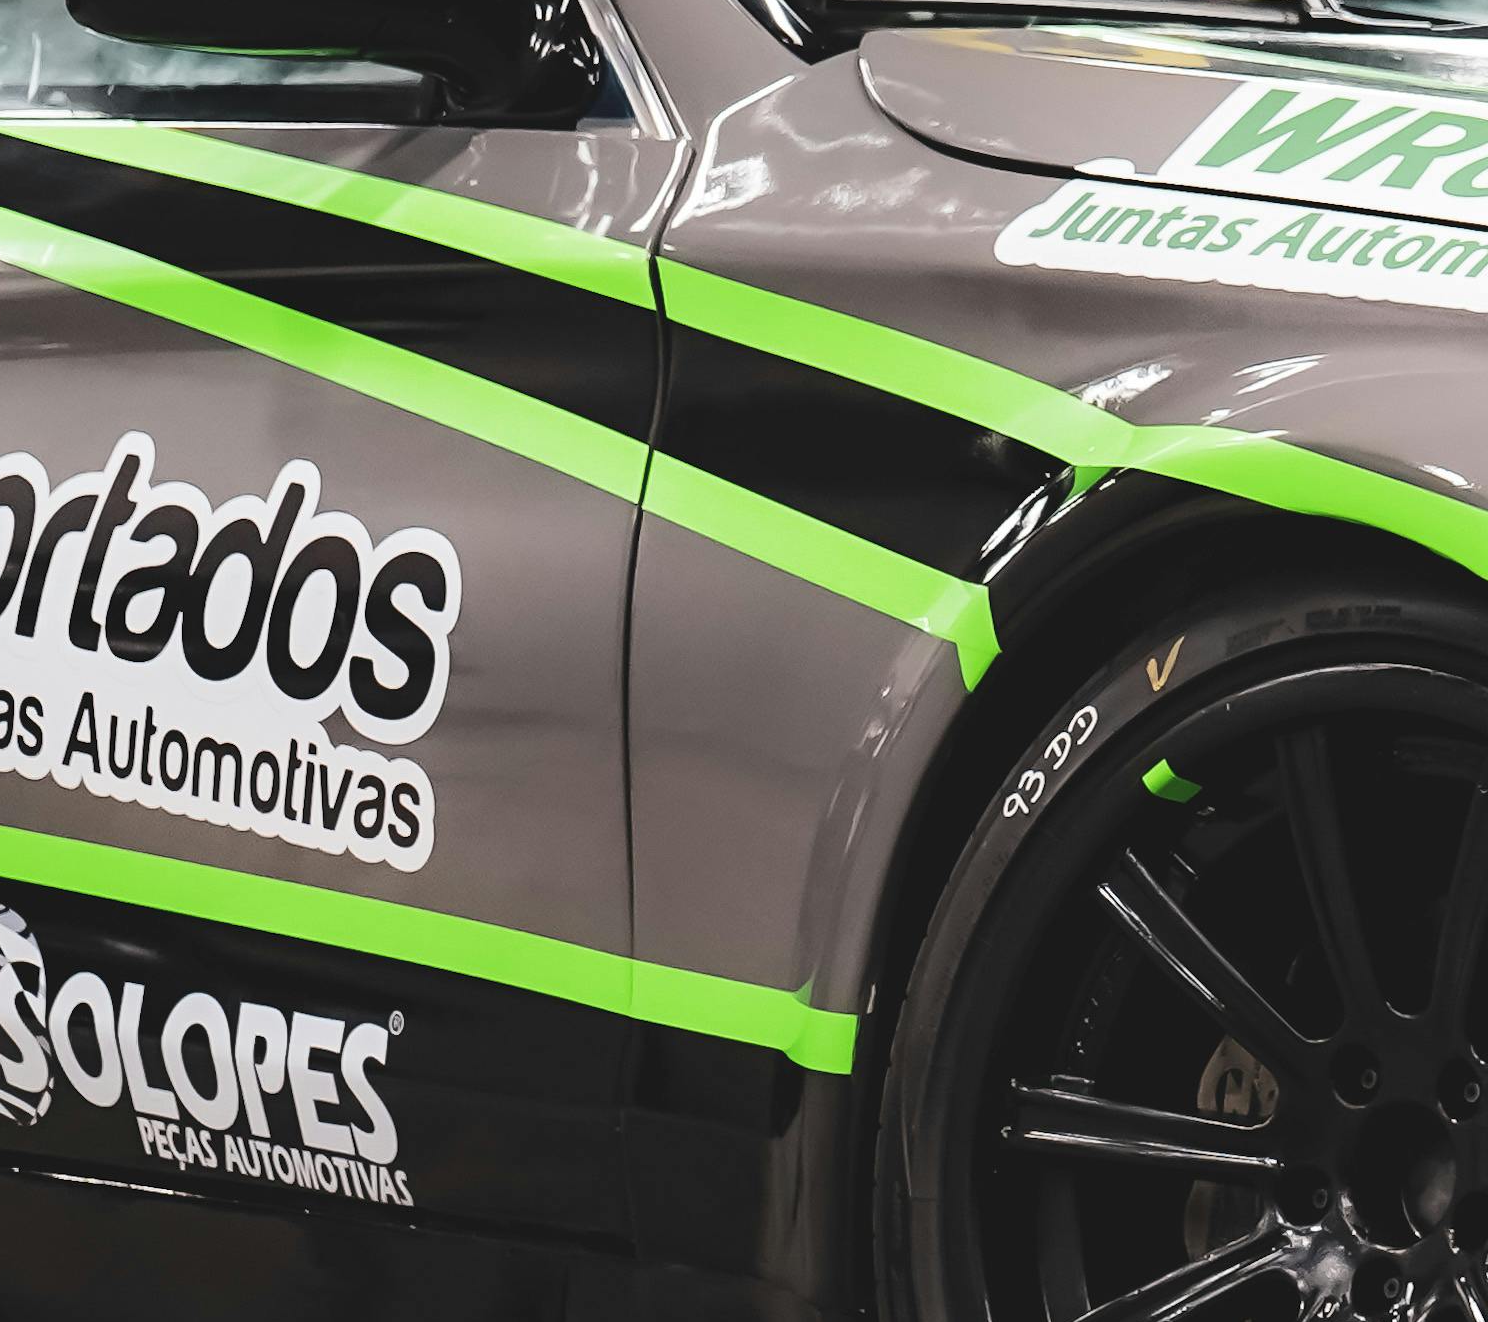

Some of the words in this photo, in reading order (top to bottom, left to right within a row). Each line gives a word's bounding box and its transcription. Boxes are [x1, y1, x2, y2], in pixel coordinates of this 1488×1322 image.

[1029, 191, 1260, 254] Juntas
[62, 690, 421, 845] Automotivas
[1002, 769, 1046, 818] 93
[137, 1116, 218, 1170] PEÇAS
[225, 1140, 414, 1206] AUTOMOTIVAS
